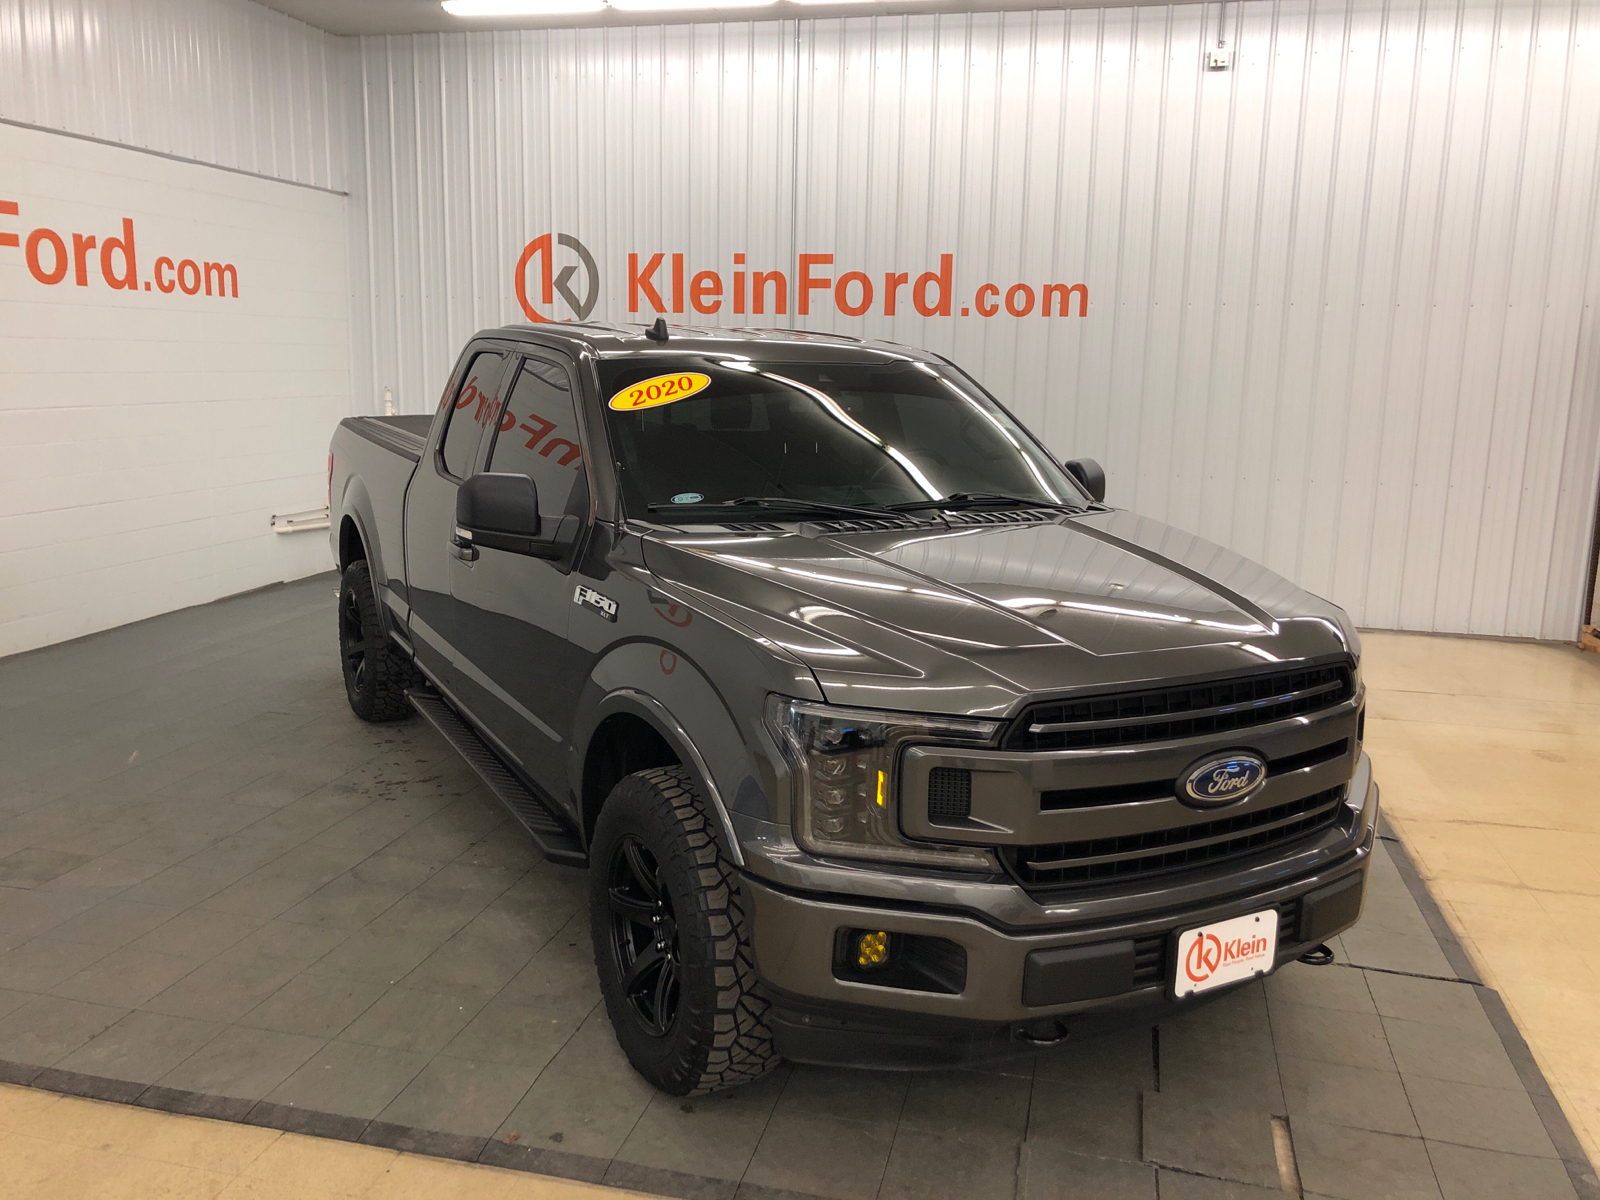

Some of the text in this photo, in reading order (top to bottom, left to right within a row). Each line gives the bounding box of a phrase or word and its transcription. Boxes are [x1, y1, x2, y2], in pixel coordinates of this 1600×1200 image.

[627, 252, 1089, 319] KleinFord.com
[629, 376, 693, 407] 2020
[1207, 766, 1251, 794] Ford
[1223, 934, 1267, 962] Klein
